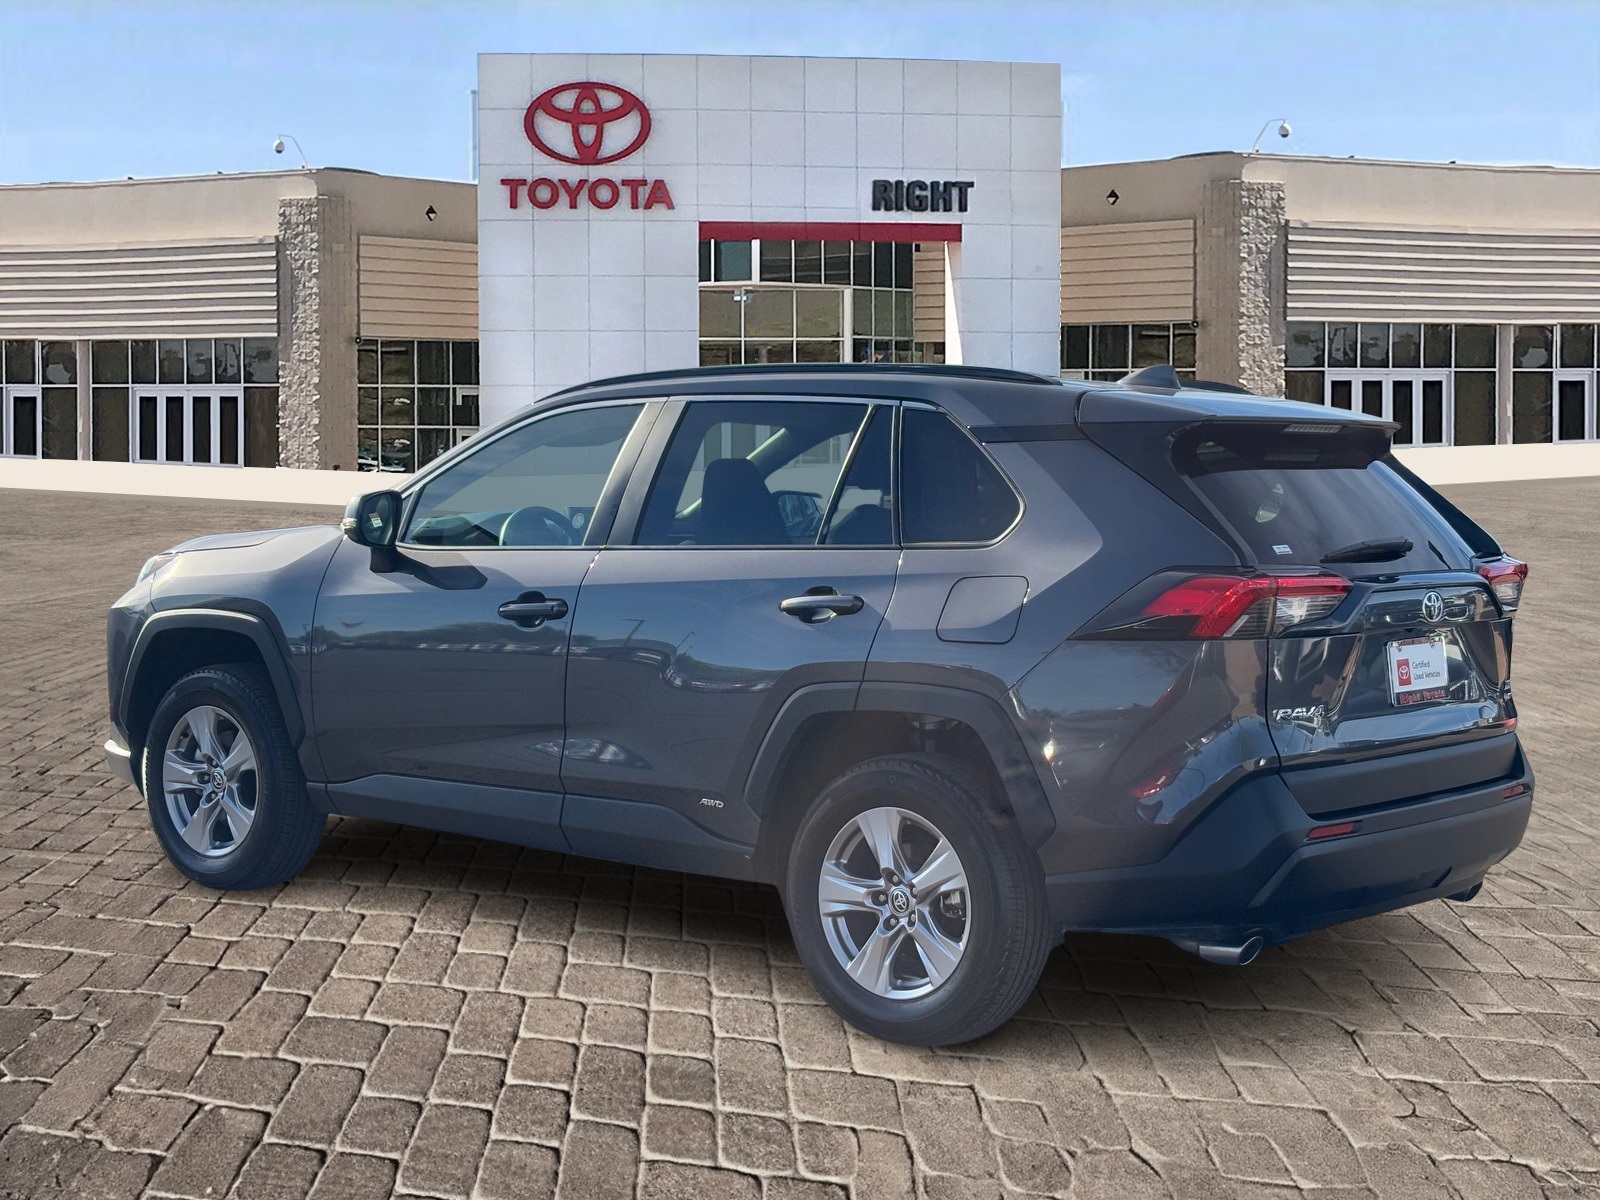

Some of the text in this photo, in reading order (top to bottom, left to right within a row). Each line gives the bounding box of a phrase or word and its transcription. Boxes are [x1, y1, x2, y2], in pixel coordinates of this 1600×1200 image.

[500, 178, 675, 210] TOYOTA
[871, 179, 974, 213] RIGHT
[1412, 660, 1430, 669] Certified
[1414, 671, 1440, 680] Used Vehicles
[699, 798, 724, 808] AWD
